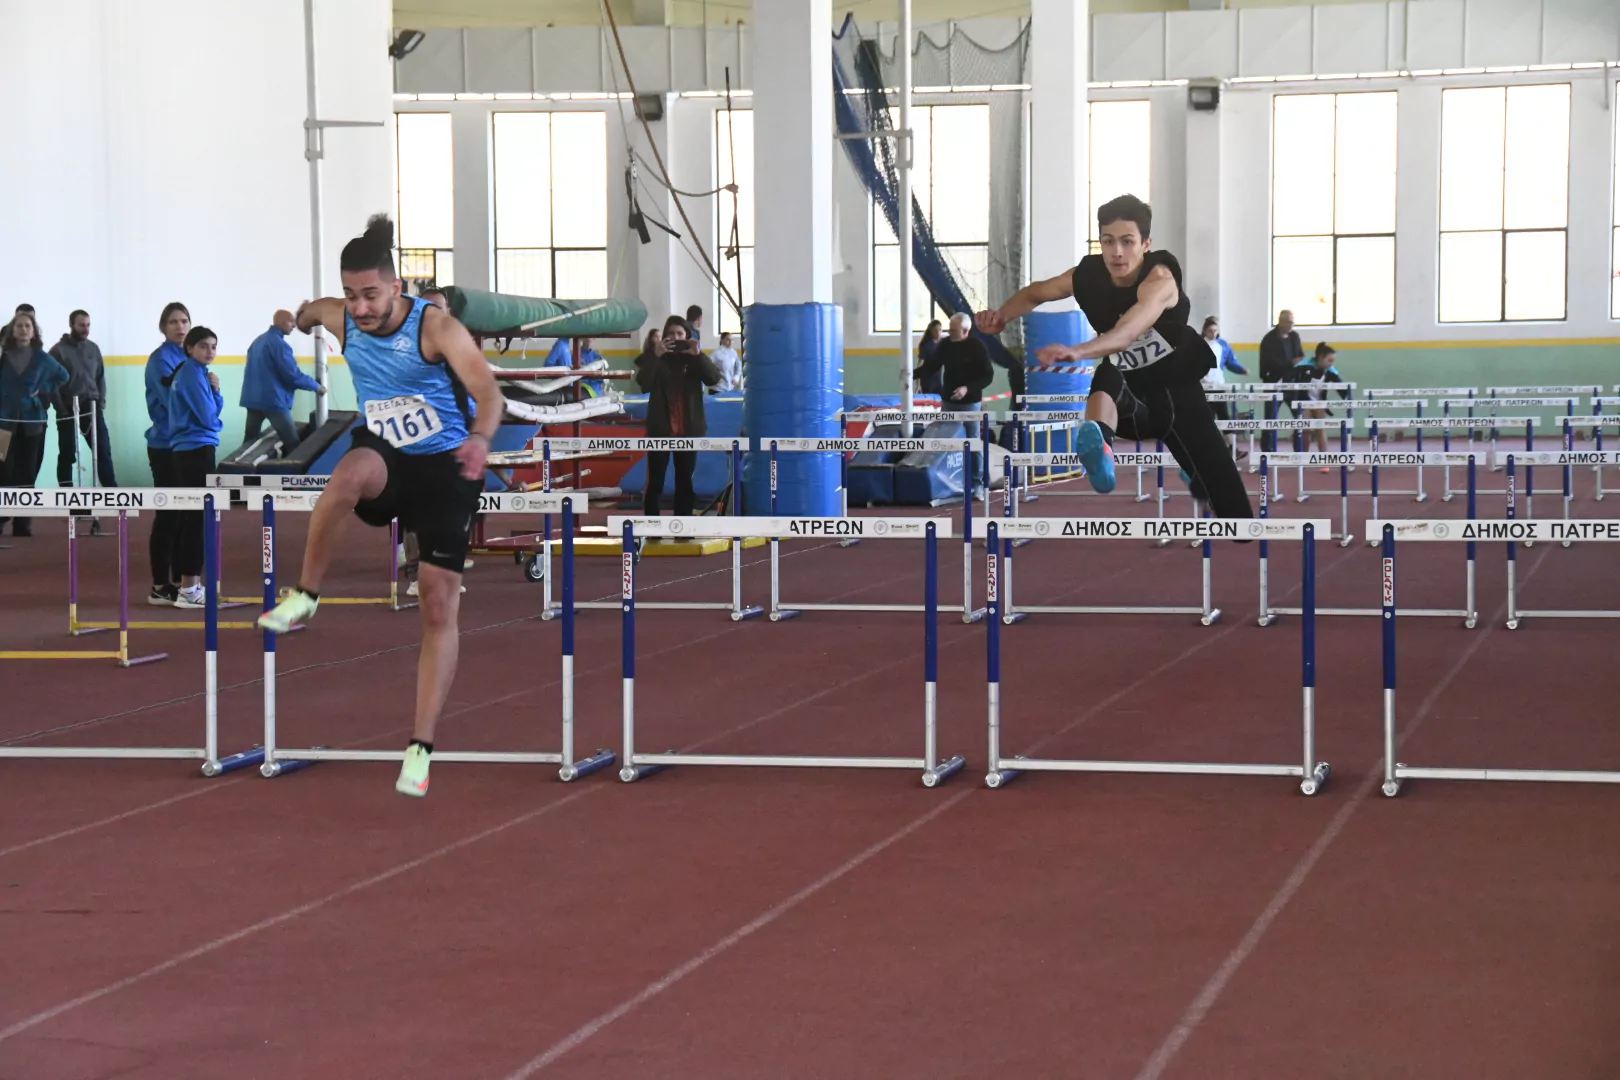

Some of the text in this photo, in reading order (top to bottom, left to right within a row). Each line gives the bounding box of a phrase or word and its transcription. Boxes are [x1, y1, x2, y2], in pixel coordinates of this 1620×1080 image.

[1116, 341, 1167, 370] 2072
[874, 413, 955, 421] ΔΗΜΟΣ ΠΑΤΡΕΩΝ
[1047, 412, 1080, 420] ΔΗΜΟΣ
[1408, 418, 1496, 427] ΔΗΜΟΣ ΠΑΤΡΕΩΝ
[373, 408, 433, 442] 2161
[1226, 420, 1311, 429] ΔΗΜΟΣ ΠΑΤΡΕΩΝ
[588, 439, 694, 449] ΔΗΜΟΣ ΠΑΤΡΕΩΝ
[817, 440, 925, 450] ΔΗΜΟΣ ΠΑΤΡΕΩΝ
[1051, 454, 1162, 465] ΔΗΜ ΑΤΡΕΩΝ
[1309, 454, 1426, 464] ΔΗΜΟΣ ΠΑΤΡΕΩΝ
[1558, 453, 1608, 463] ΔΗΜΟΣ
[0, 492, 143, 507] ΜΟΣ ΠΑΤΡΕΩΝ
[790, 520, 863, 535] ΑΤΡΕΩΝ
[1061, 521, 1237, 537] ΔΗΜΟΣ ΠΑΤΡΕΩΝ
[1461, 523, 1538, 538] ΔΗΜΟΣ
[263, 528, 271, 569] POLANIK
[623, 554, 631, 595] POLANIK
[988, 556, 996, 598] POLANIK
[1384, 559, 1392, 602] POLANIK
